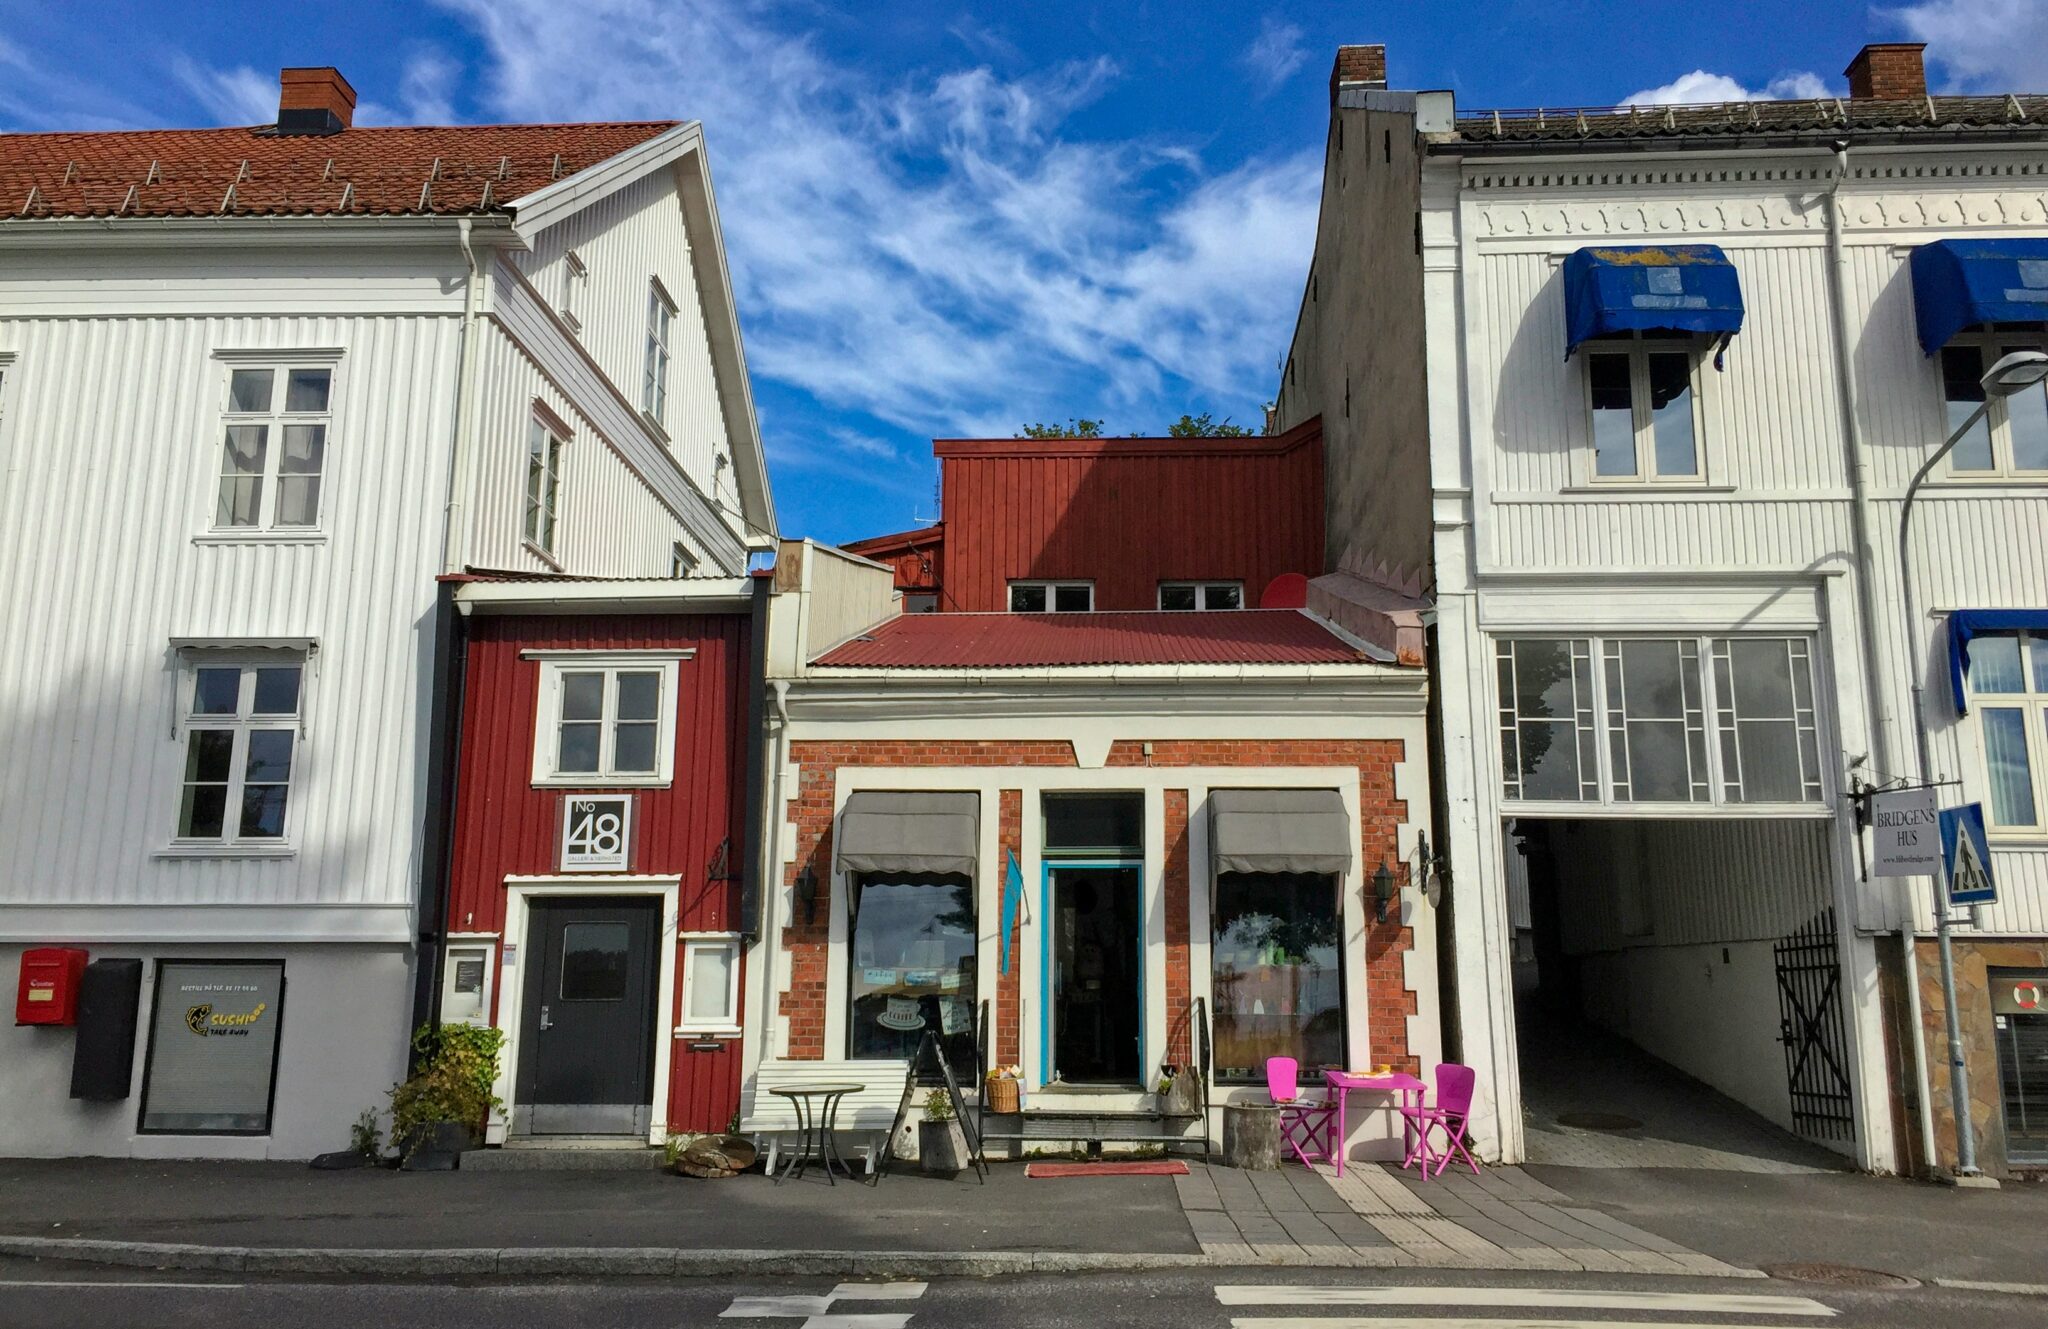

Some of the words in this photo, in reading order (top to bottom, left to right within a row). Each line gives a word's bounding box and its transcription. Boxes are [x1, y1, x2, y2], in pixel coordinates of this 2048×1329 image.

[576, 801, 595, 813] No
[1877, 808, 1936, 828] BRIDGENS
[568, 813, 620, 855] 48
[1897, 830, 1918, 847] HUS
[211, 1013, 250, 1026] SUSHI
[229, 1029, 249, 1037] AWAY
